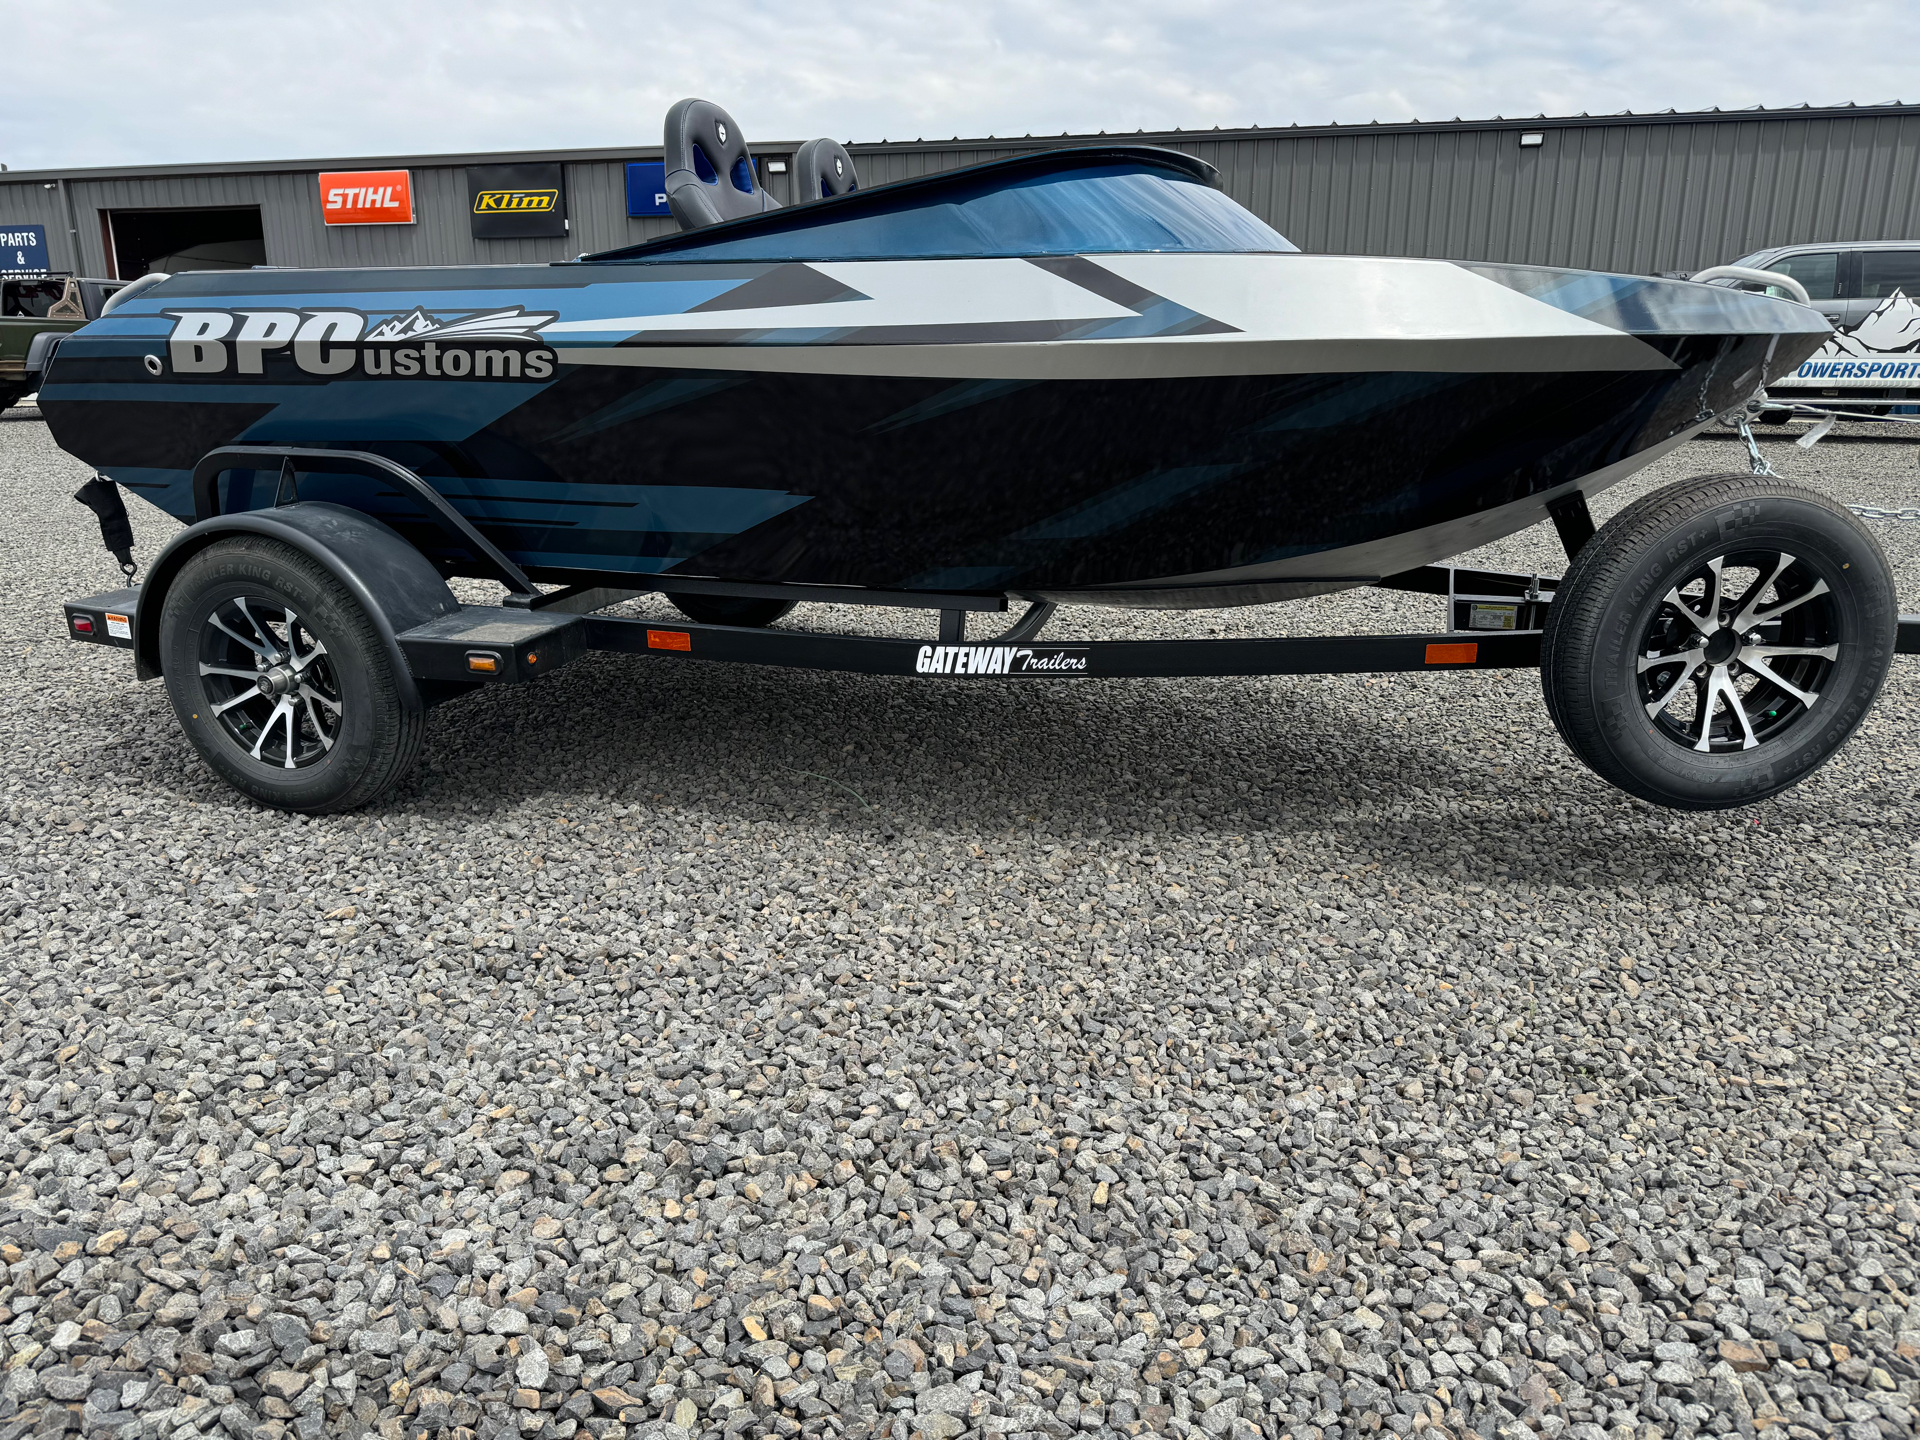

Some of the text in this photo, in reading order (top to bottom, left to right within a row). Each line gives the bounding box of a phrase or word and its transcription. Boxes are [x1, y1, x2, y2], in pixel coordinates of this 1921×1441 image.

[326, 186, 400, 209] STIHL
[478, 193, 550, 210] Klim
[0, 232, 37, 247] PARTS
[16, 250, 26, 265] &
[1784, 361, 1921, 378] OWERSPORT
[188, 563, 234, 592] TRAILER
[238, 563, 271, 582] KING
[1604, 611, 1632, 690] TRAILER
[1628, 562, 1663, 608] KING
[915, 645, 1088, 675] GATEWAY Trailers
[1826, 704, 1860, 744] KING
